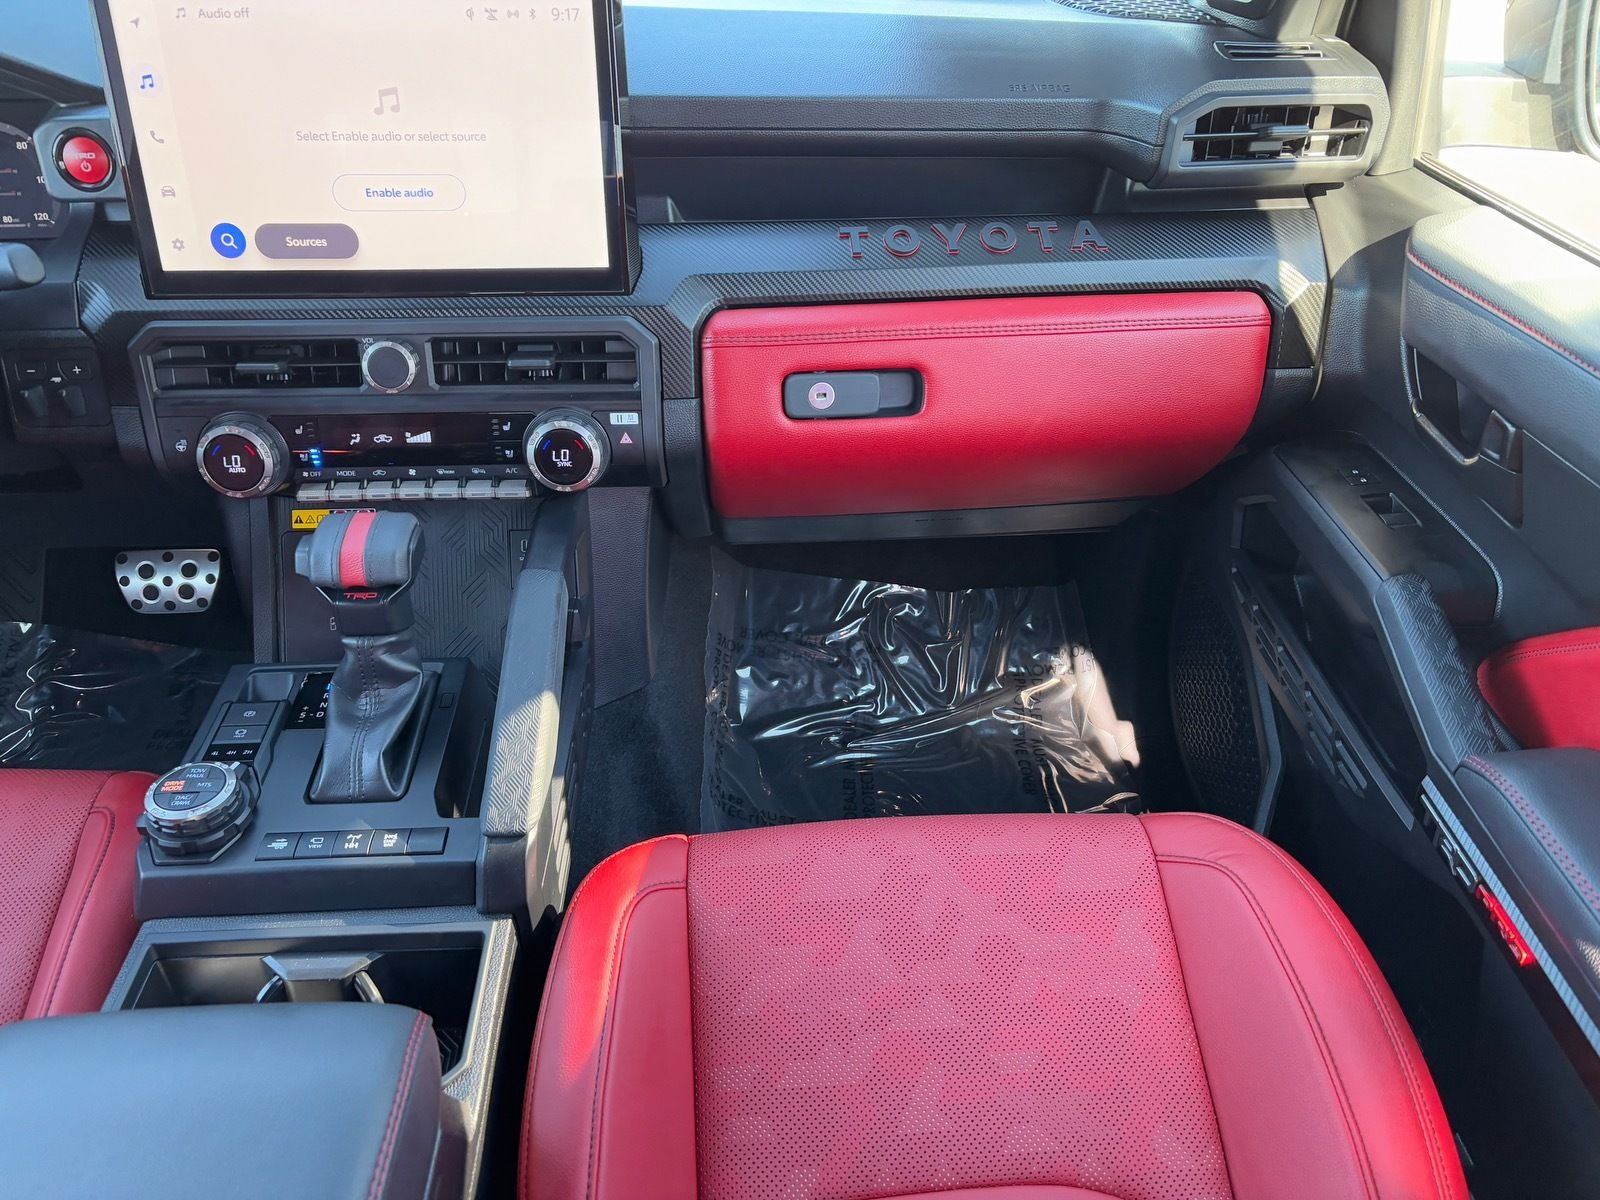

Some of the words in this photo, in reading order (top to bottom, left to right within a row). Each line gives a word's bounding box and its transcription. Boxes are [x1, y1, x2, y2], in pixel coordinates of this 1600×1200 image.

[198, 8, 231, 19] Audio
[234, 8, 249, 19] off
[551, 7, 580, 21] 9:17
[295, 130, 329, 142] Select
[331, 131, 369, 142] Enable
[371, 131, 402, 142] audio
[403, 132, 416, 142] or
[418, 131, 449, 142] select
[451, 132, 487, 142] source
[16, 141, 28, 150] 80
[365, 187, 402, 198] Enable
[403, 187, 434, 198] audio
[33, 212, 48, 221] 120
[285, 236, 328, 248] Sources
[838, 218, 1110, 260] TOYOTA
[343, 592, 378, 600] TRD
